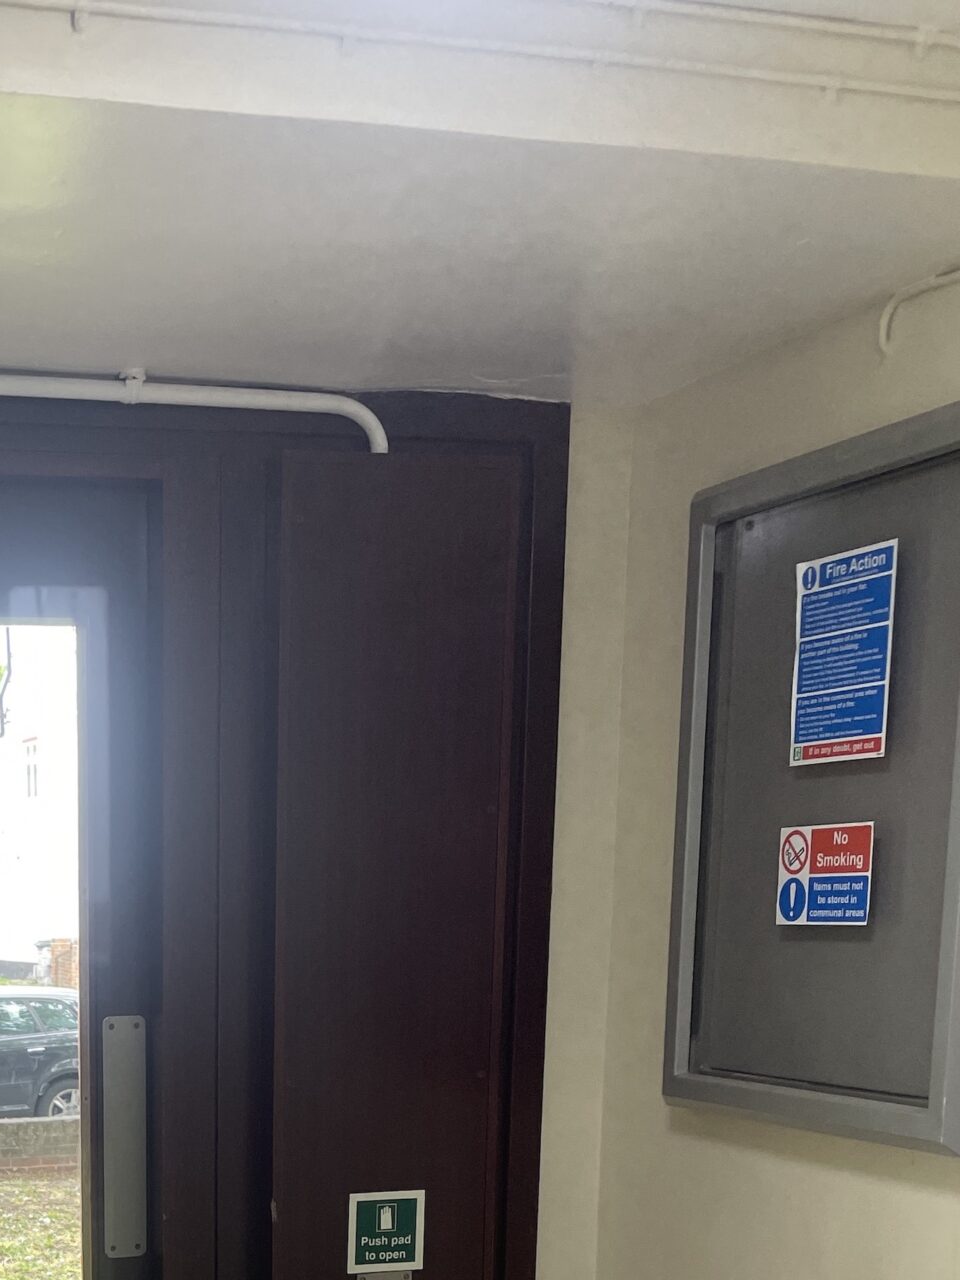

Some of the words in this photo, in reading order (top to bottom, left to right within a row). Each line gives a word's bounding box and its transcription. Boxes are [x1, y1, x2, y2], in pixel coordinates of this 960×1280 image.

[826, 562, 847, 579] Fire
[849, 553, 886, 573] Action
[852, 743, 863, 752] get
[864, 741, 874, 749] out
[833, 831, 848, 845] No
[816, 852, 863, 869] Smoking
[813, 882, 831, 891] Items
[833, 882, 850, 890] must
[851, 882, 863, 890] not
[817, 895, 826, 904] be
[827, 895, 849, 904] stored
[850, 895, 857, 903] in
[809, 909, 844, 917] communal
[845, 909, 864, 917] areas
[361, 1235, 388, 1247] Push
[391, 1234, 411, 1248] pad
[365, 1251, 375, 1261] to
[379, 1250, 406, 1262] open
